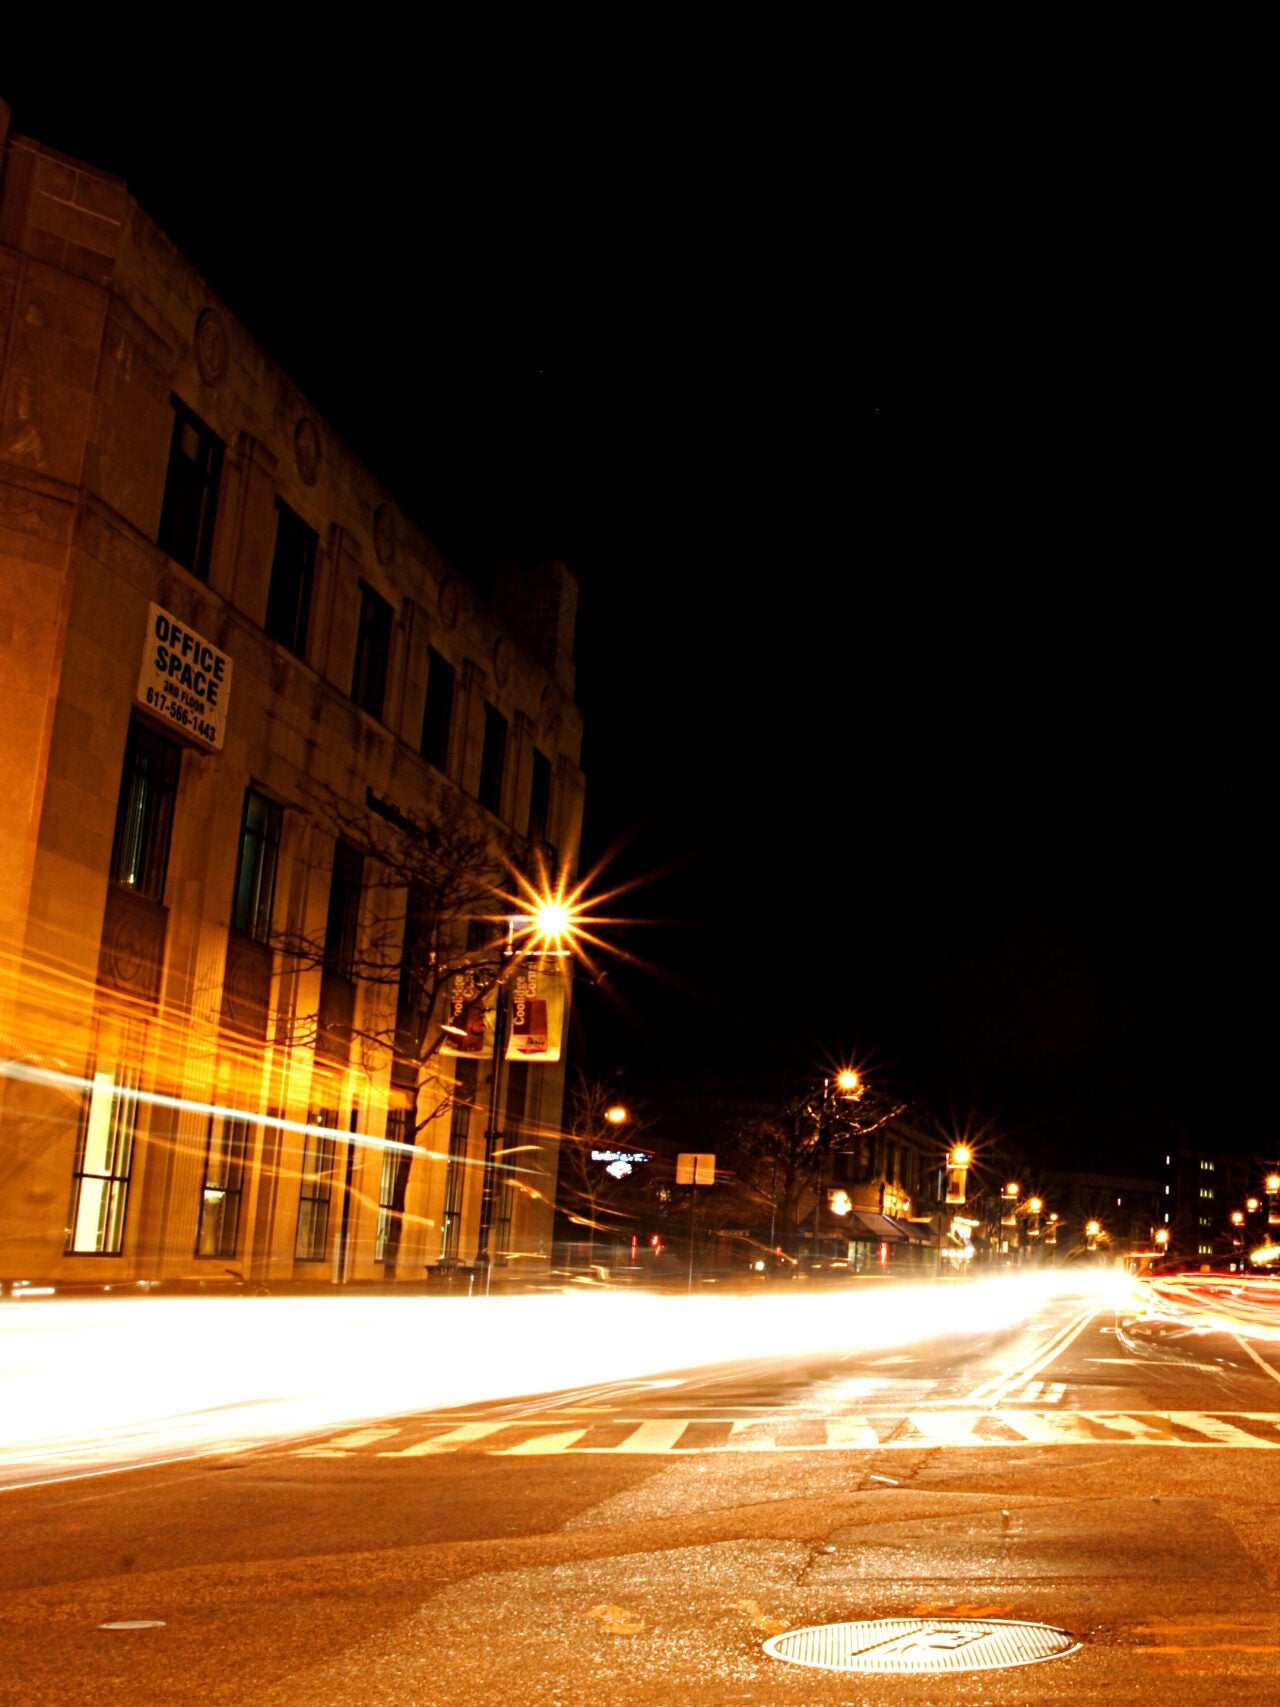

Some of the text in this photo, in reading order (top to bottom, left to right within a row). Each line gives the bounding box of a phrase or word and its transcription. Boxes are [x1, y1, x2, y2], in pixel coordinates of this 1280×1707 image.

[155, 615, 226, 682] OFFICE
[155, 645, 219, 706] SPACE
[146, 686, 216, 742] 617-566-1443
[163, 680, 205, 715] 3RD FLOOR
[513, 976, 528, 1026] Coolidge
